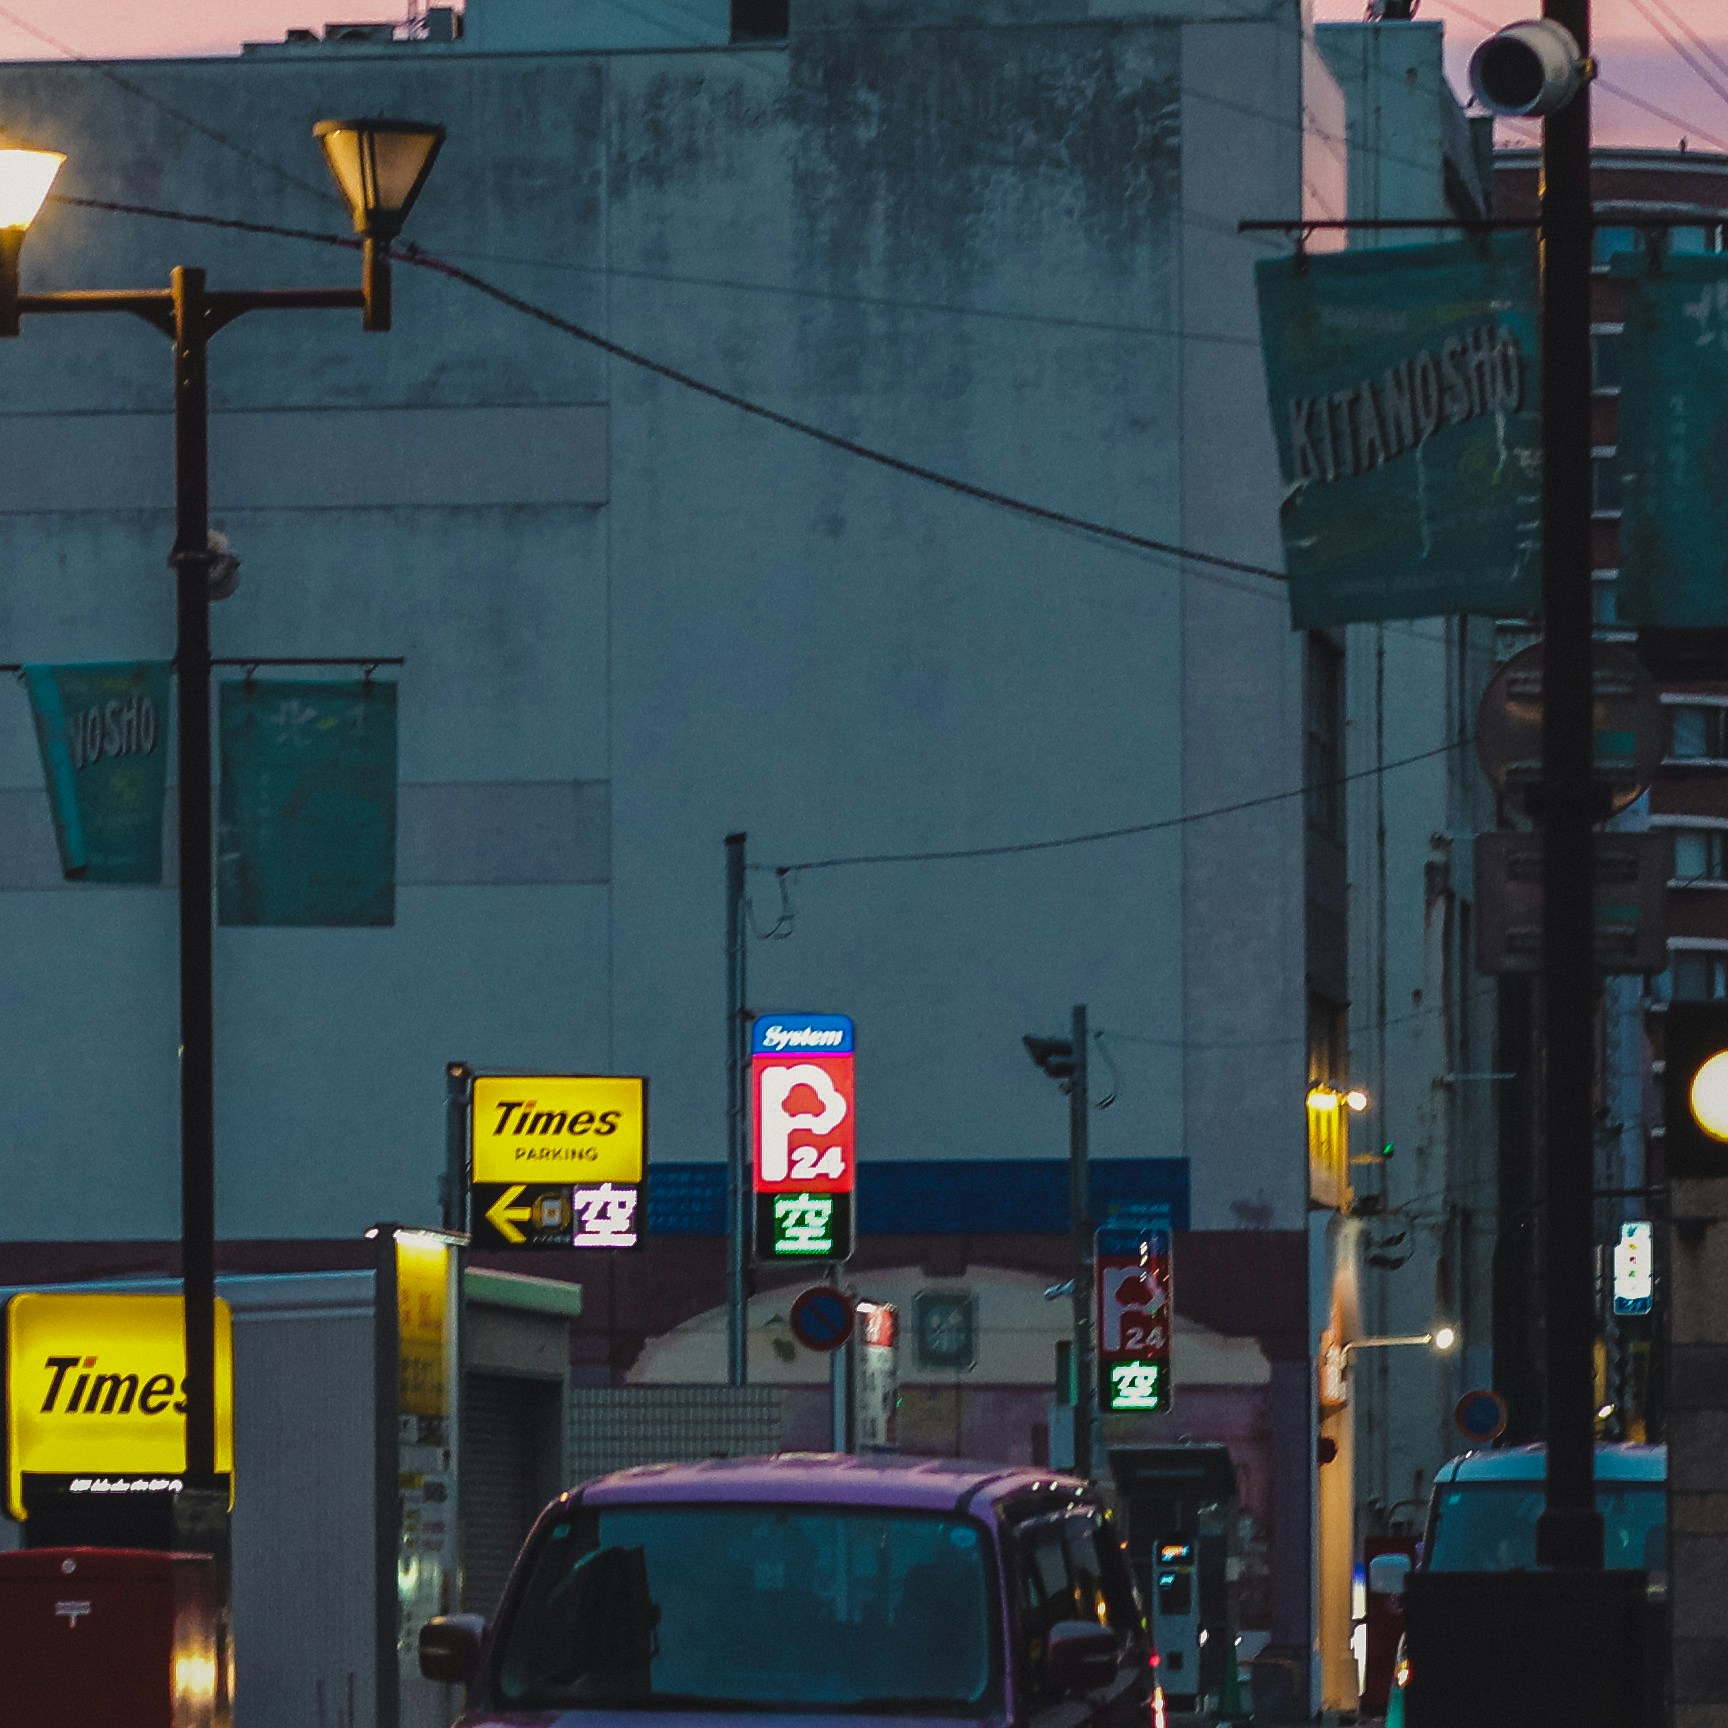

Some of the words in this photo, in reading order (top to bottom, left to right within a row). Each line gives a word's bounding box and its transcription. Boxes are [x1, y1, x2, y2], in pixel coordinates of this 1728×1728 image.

[763, 1025, 843, 1051] System
[492, 1100, 622, 1137] Times
[514, 1146, 599, 1162] PARKING
[789, 1146, 846, 1180] 24
[574, 1183, 638, 1247] 空
[774, 1192, 833, 1254] 空
[1126, 1328, 1164, 1351] 24
[1111, 1361, 1159, 1410] 空
